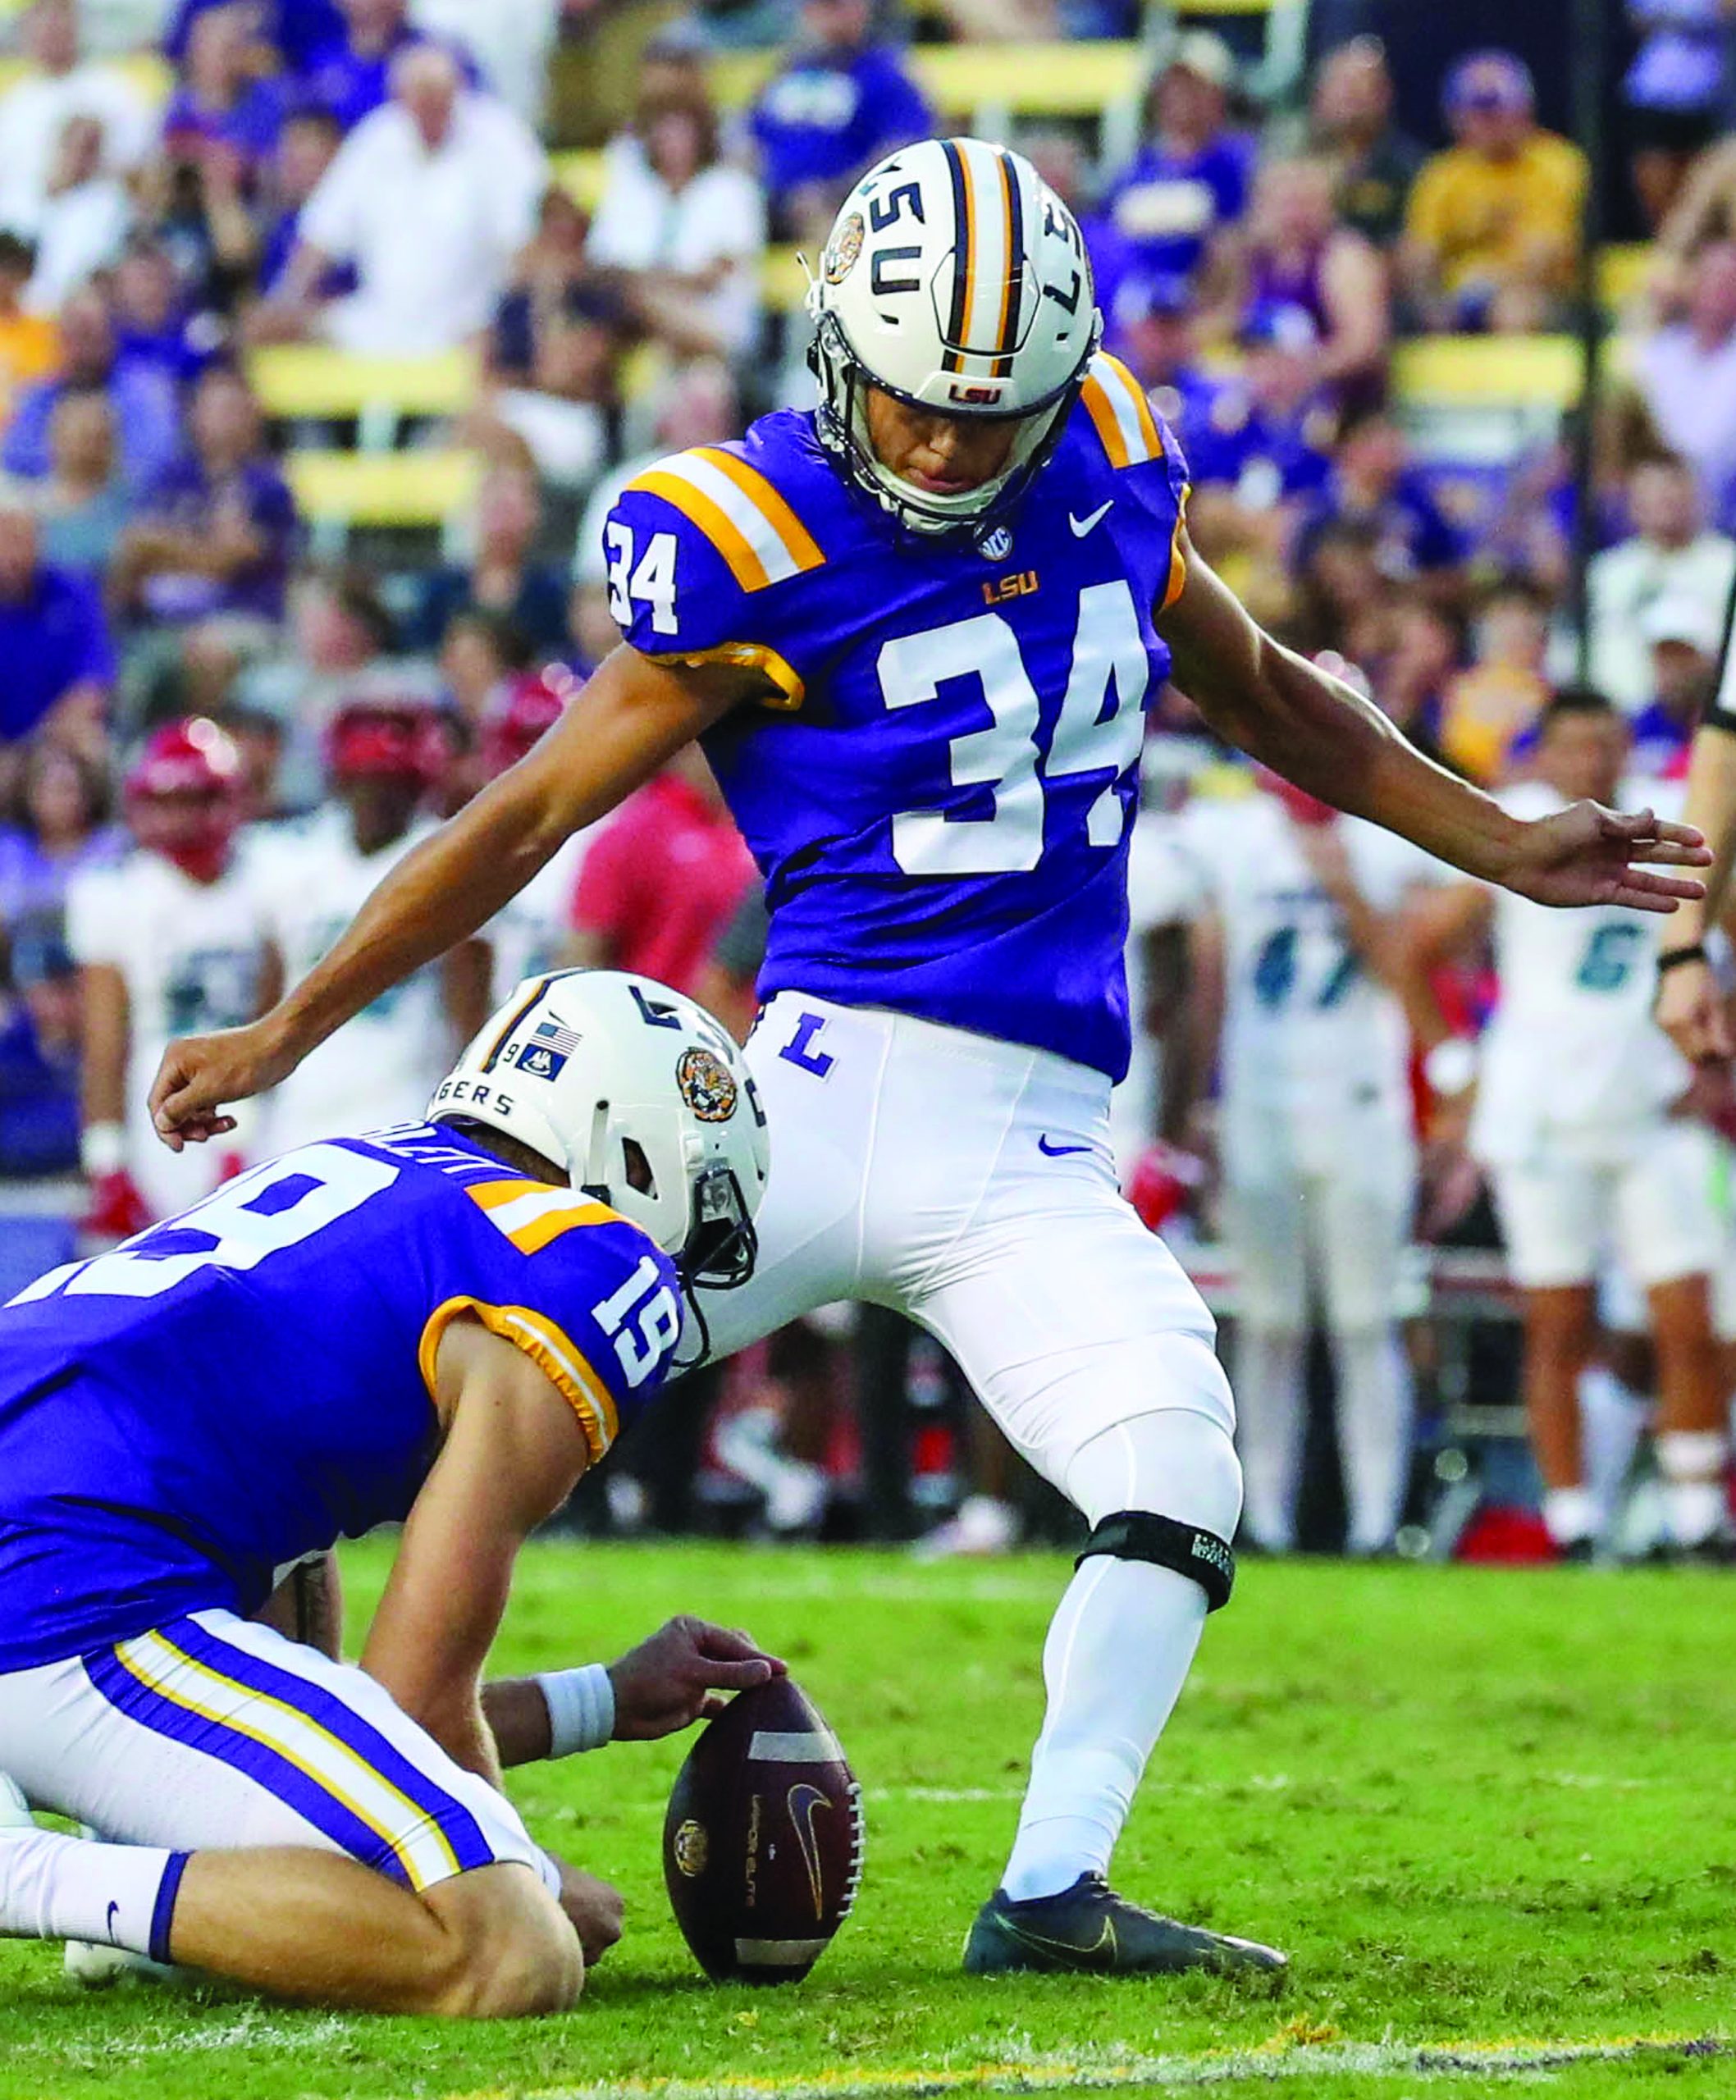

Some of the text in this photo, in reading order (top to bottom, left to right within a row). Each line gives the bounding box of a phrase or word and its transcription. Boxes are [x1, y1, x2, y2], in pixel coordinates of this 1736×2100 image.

[948, 381, 1003, 405] LSU
[606, 520, 679, 637] 34
[982, 570, 1039, 605] LSU
[875, 578, 1150, 875] 34
[778, 1011, 838, 1081] L
[436, 1080, 515, 1116] GERS
[590, 1255, 679, 1387] 19
